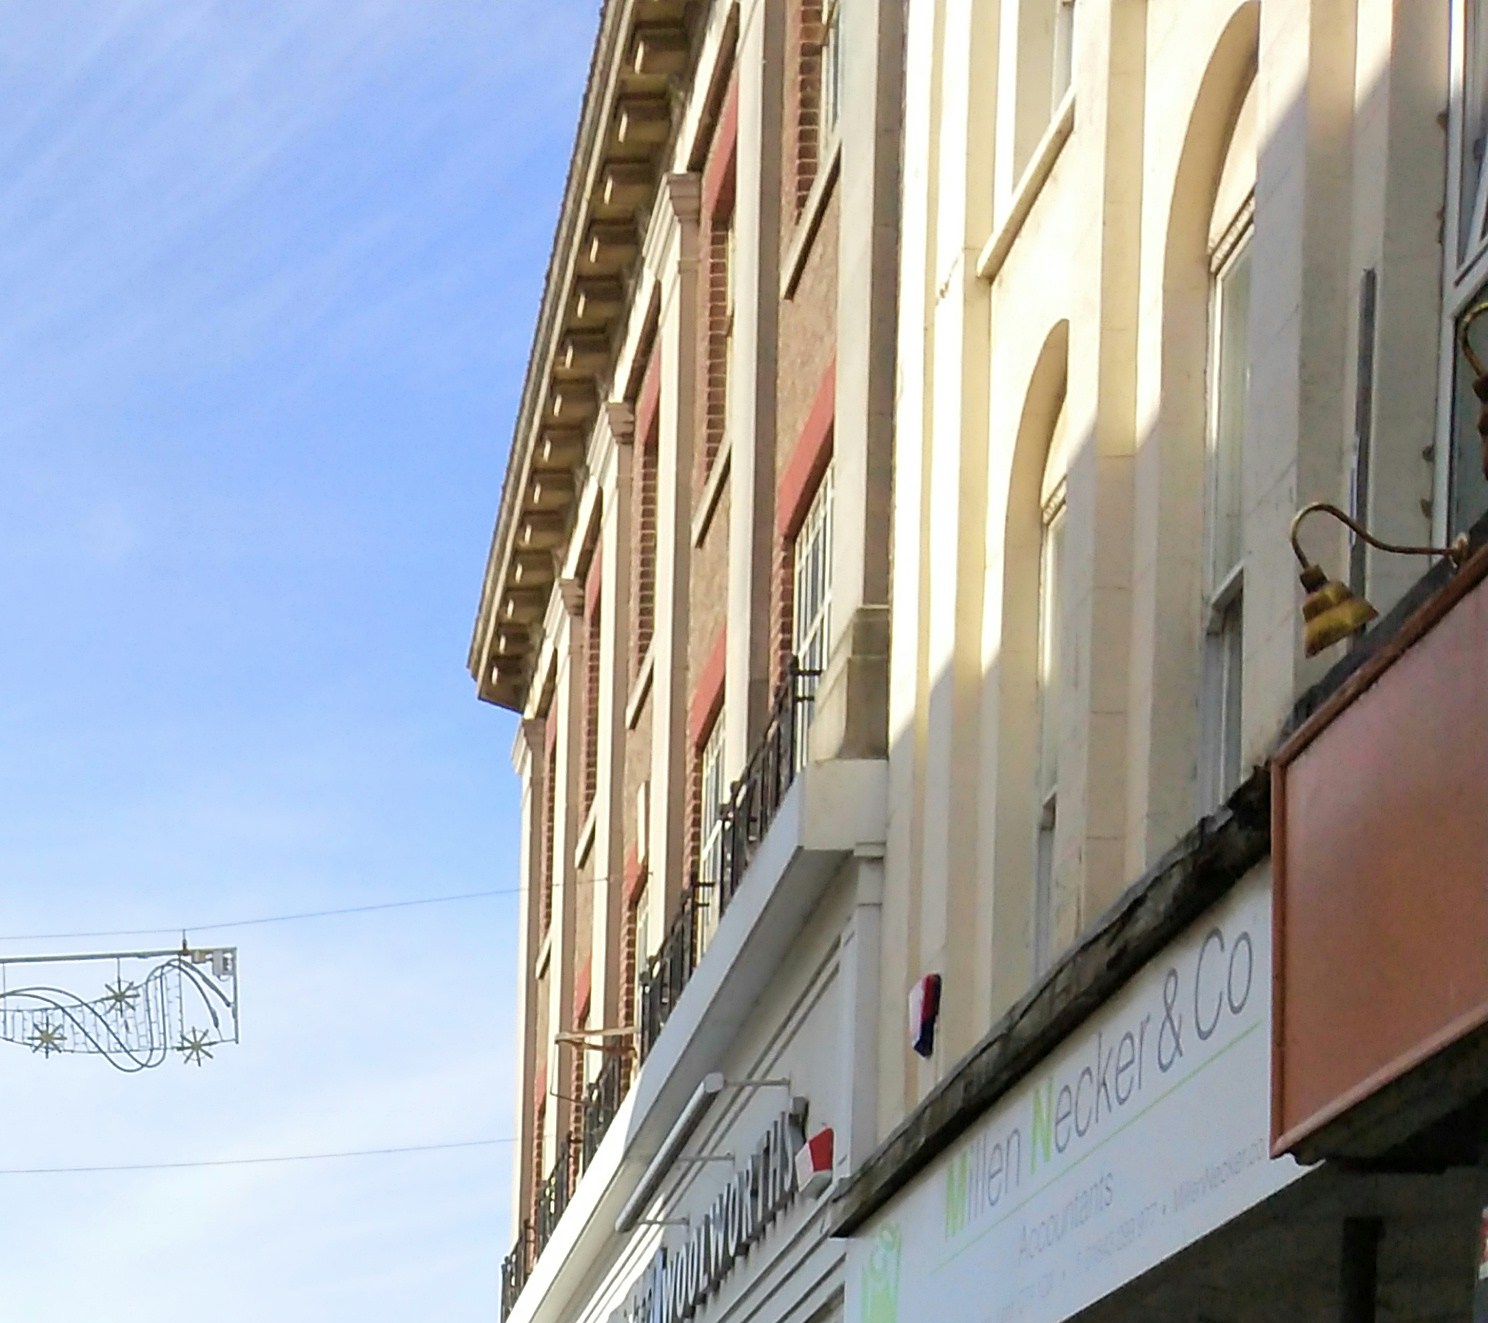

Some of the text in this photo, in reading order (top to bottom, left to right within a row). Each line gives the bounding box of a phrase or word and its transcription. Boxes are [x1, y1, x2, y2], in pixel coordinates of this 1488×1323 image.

[945, 1127, 1021, 1242] Millen
[1030, 1012, 1151, 1176] Necker
[1158, 967, 1184, 1073] &
[1194, 927, 1253, 1041] Co
[1017, 1172, 1113, 1264] Accountants
